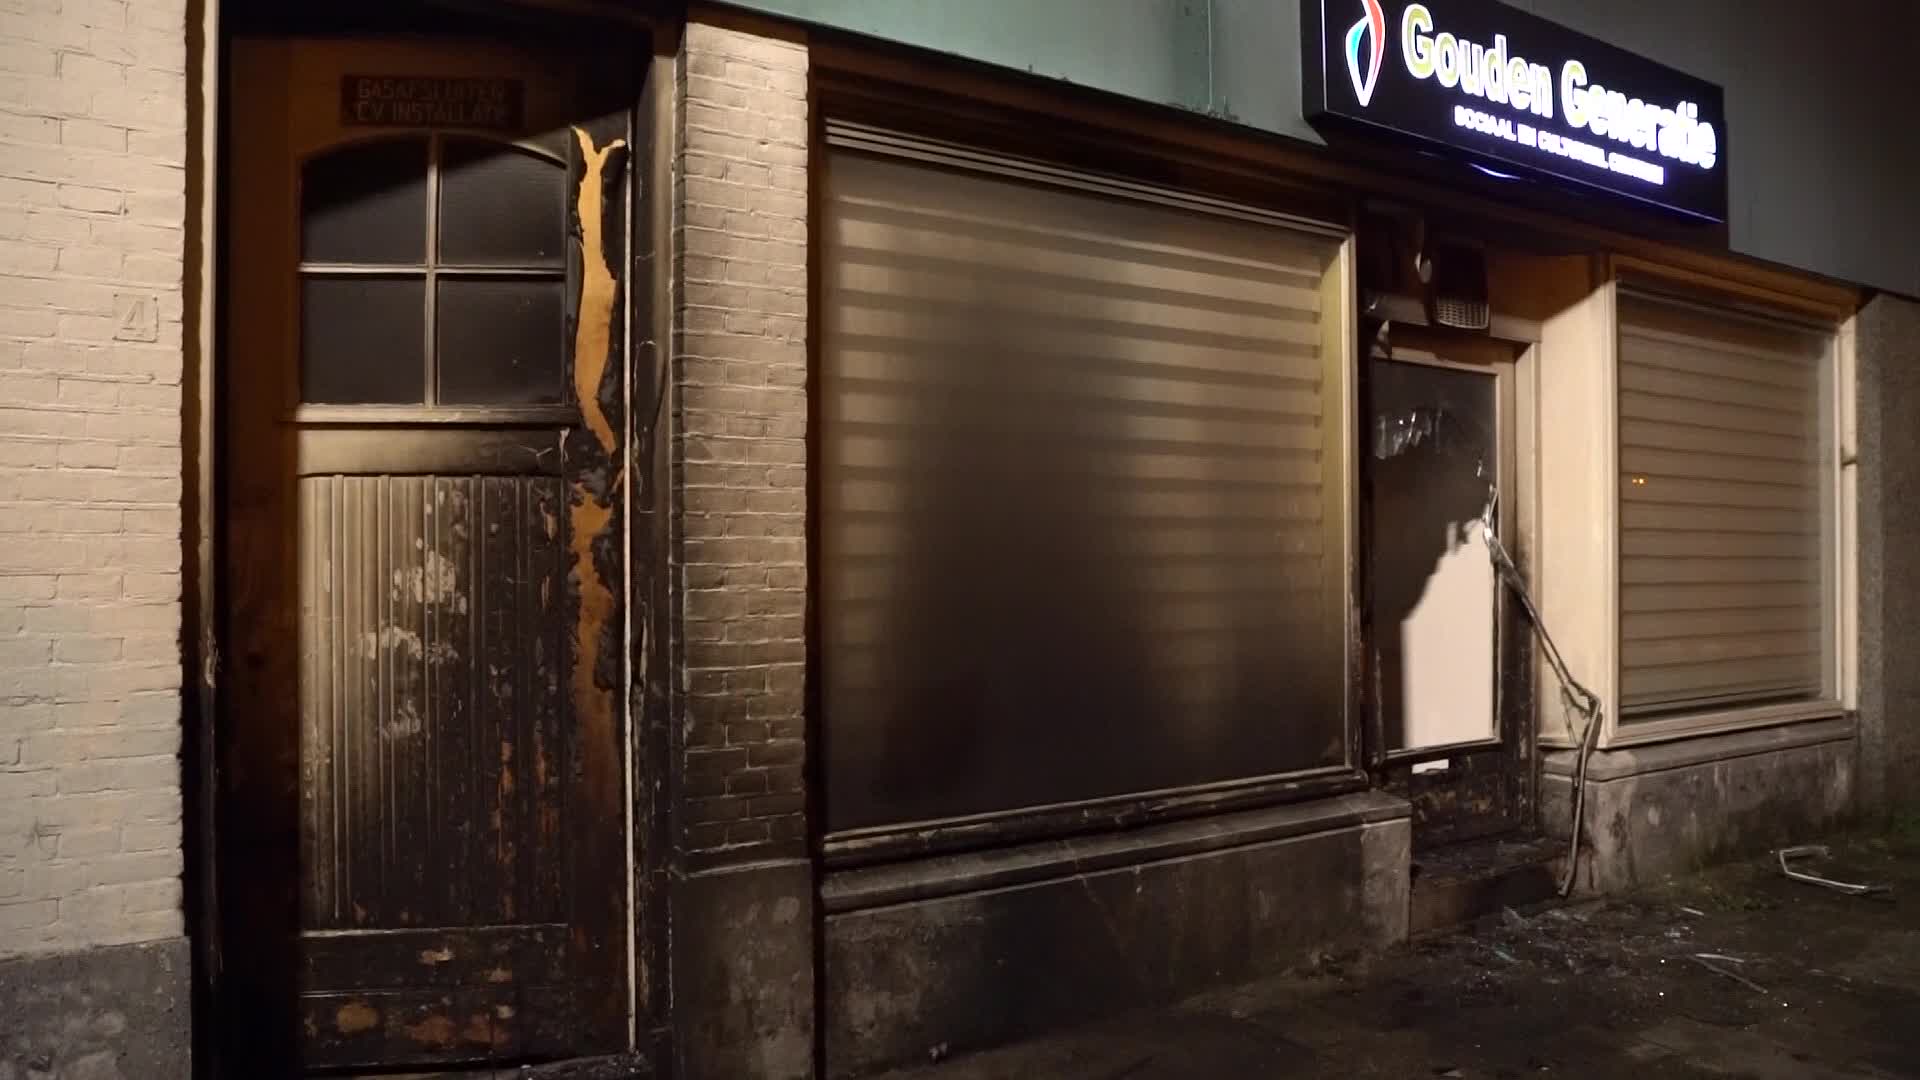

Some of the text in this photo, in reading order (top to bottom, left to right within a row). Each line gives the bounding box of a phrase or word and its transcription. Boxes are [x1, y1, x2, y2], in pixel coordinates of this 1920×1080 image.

[1402, 4, 1717, 170] Gouden Generatie
[356, 101, 384, 122] CV
[120, 297, 146, 338] 4
